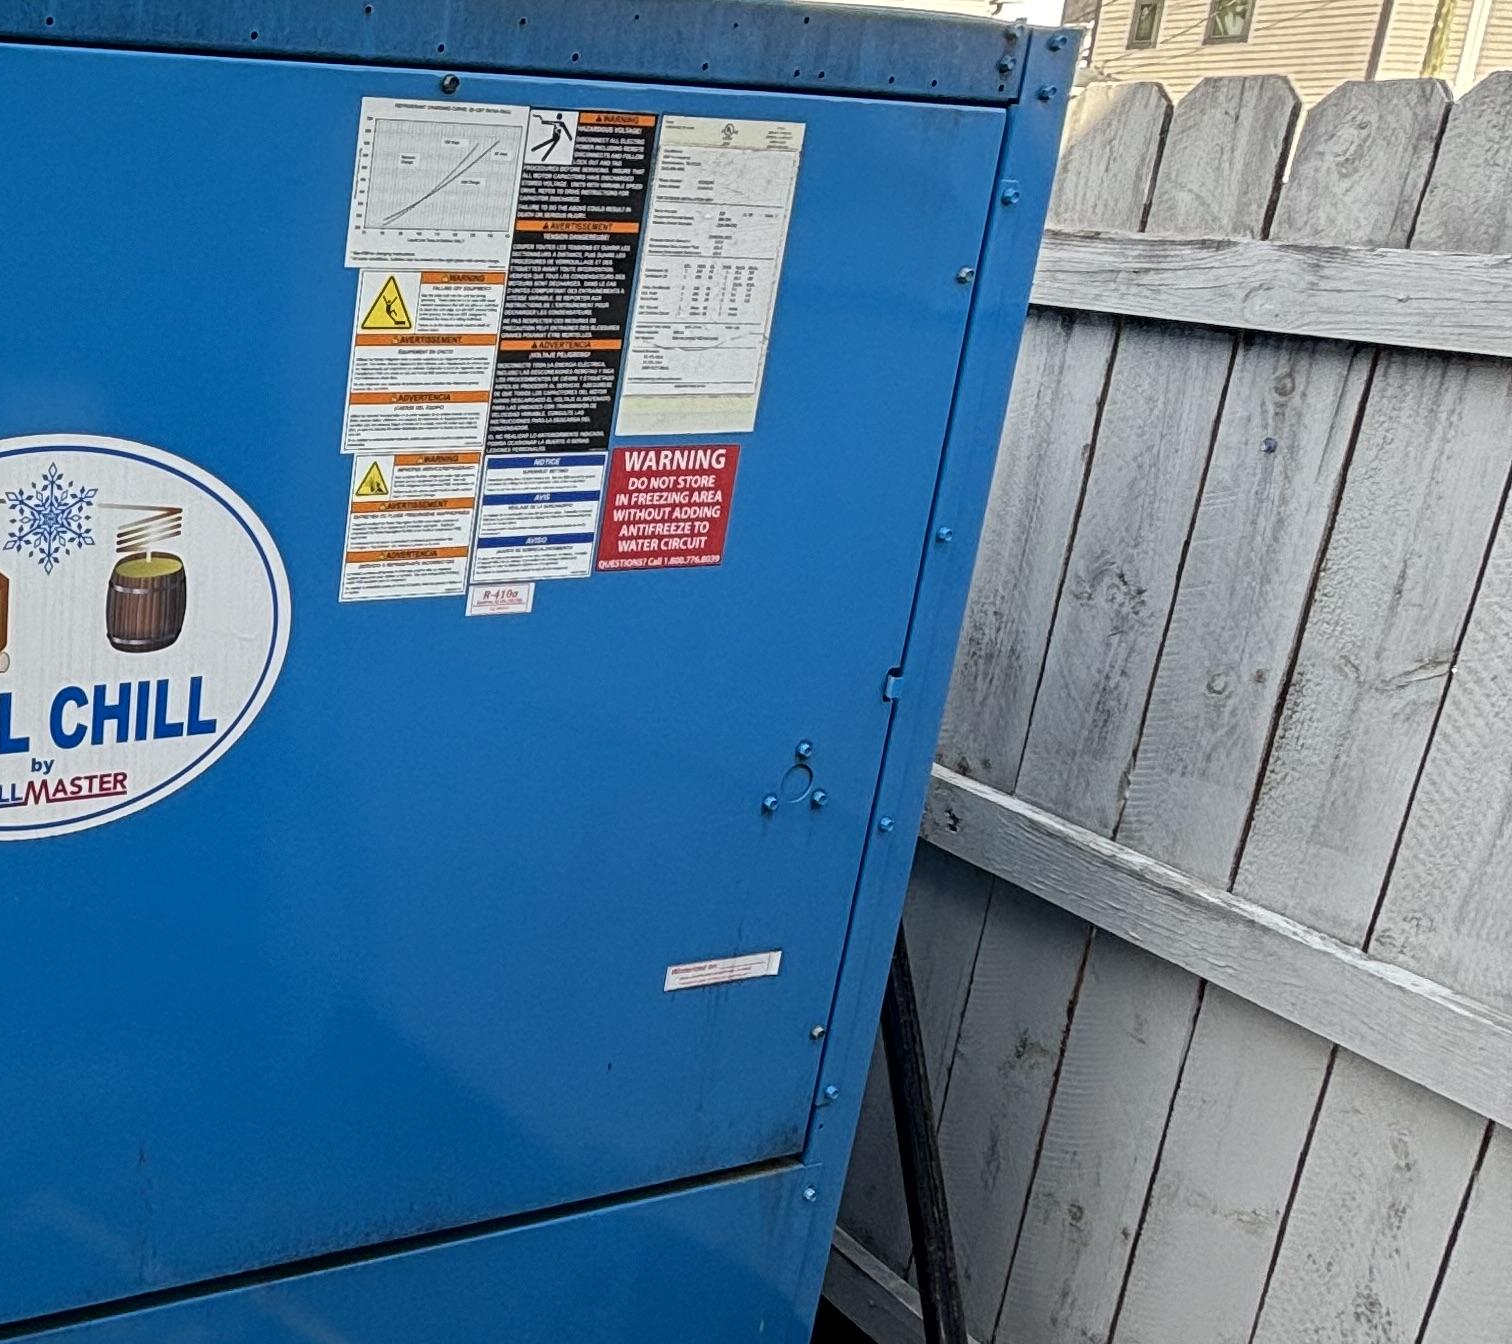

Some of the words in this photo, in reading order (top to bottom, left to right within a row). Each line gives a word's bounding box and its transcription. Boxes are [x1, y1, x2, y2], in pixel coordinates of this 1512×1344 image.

[550, 221, 613, 231] AVERTISSEMENT
[449, 275, 485, 283] WARNING
[398, 393, 451, 402] ADVERTENCIA
[533, 458, 561, 466] NOTICE
[624, 449, 726, 472] WARNING
[628, 477, 648, 490] DO
[650, 476, 676, 489] NOT
[677, 475, 716, 488] STORE
[533, 493, 551, 501] AVIS
[615, 493, 629, 506] IN
[631, 491, 689, 505] FREEZING
[690, 490, 723, 503] AREA
[387, 500, 448, 510] AVERTISSEMENT
[613, 507, 671, 522] WITHOUT
[672, 506, 721, 519] ADDING
[619, 522, 692, 537] ANTIFREEZE
[694, 521, 710, 534] TO
[618, 539, 658, 552] WATER
[660, 536, 707, 550] CIRCUIT
[386, 550, 438, 559] ADVERTENCIA
[598, 557, 647, 569] QUESTIONS?
[648, 557, 662, 566] Call
[49, 675, 217, 750] CHILL
[30, 757, 55, 776] by
